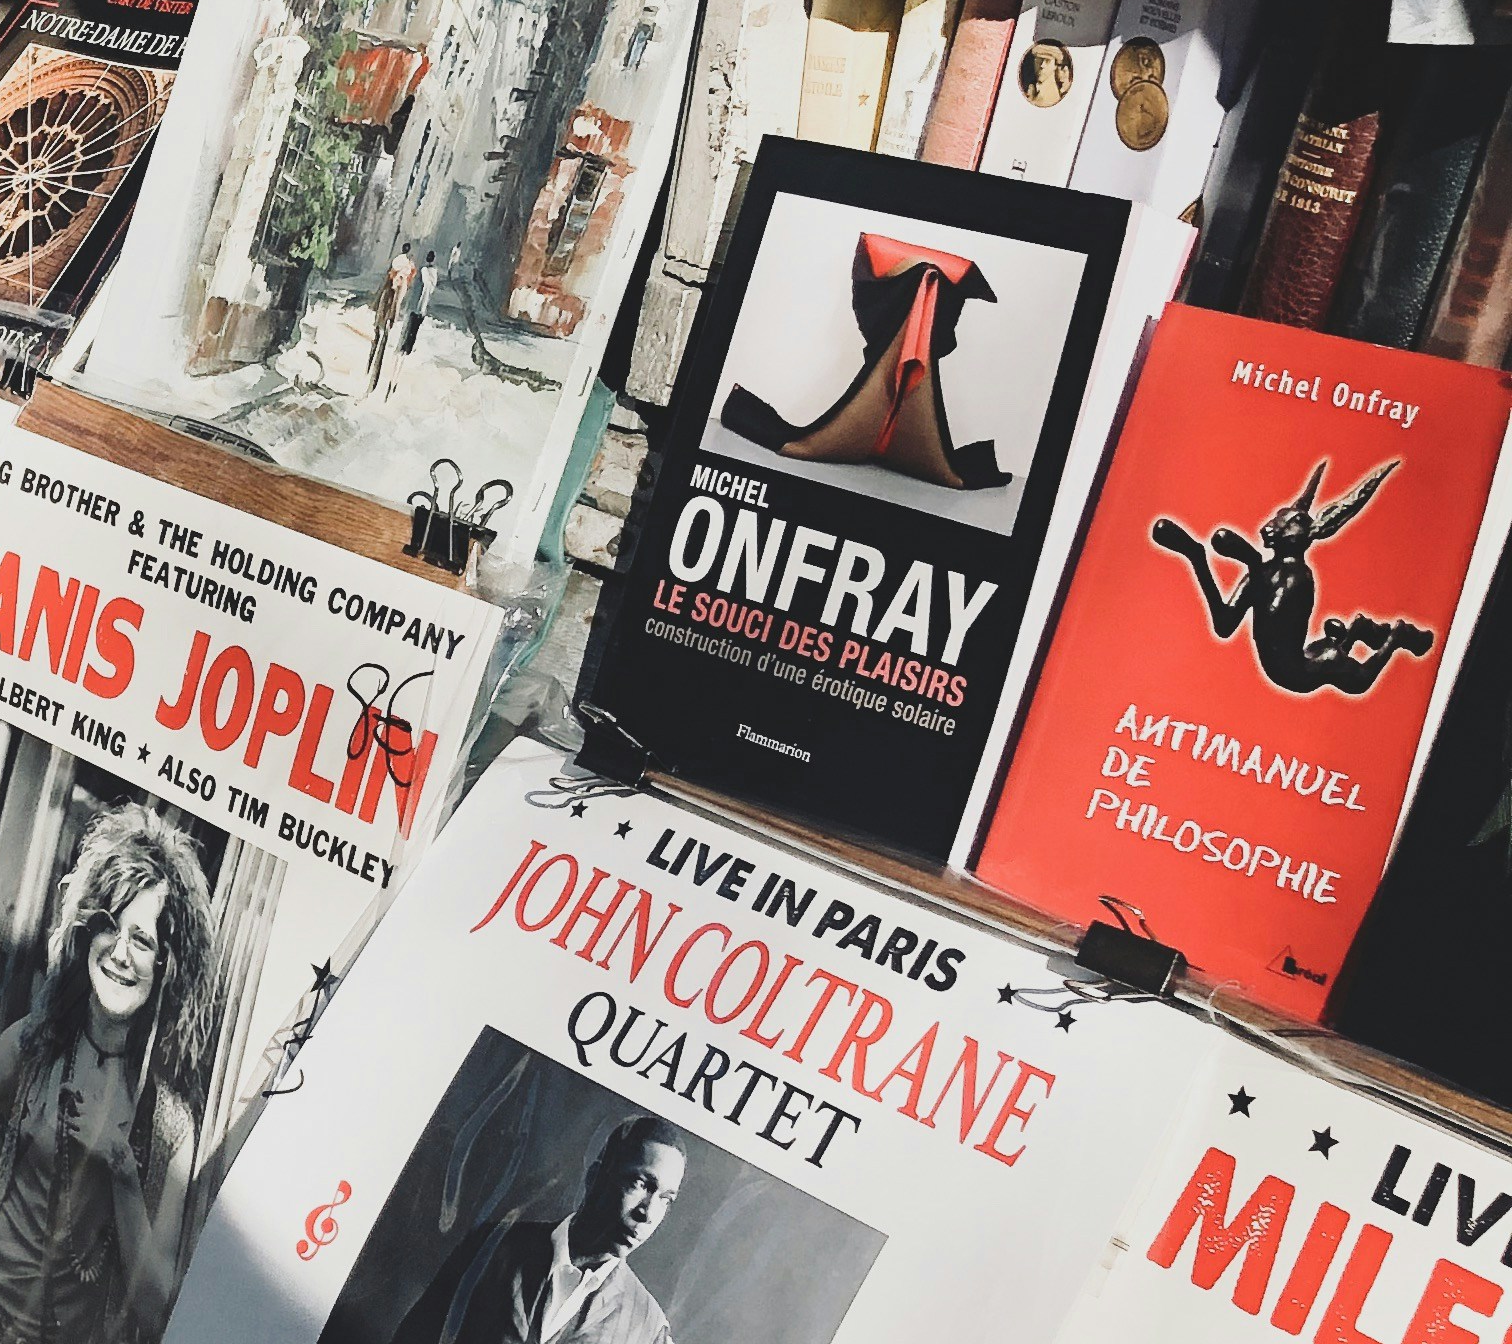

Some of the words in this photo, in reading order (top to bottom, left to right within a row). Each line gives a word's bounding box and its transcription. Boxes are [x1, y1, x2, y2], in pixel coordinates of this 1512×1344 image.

[20, 9, 152, 54] NOTRE-DAME
[145, 34, 180, 57] DE
[1041, 9, 1076, 27] LEROUX
[1290, 175, 1357, 204] CONSCRIT
[1290, 195, 1321, 214] 1813
[1230, 359, 1321, 402] Michel
[1331, 381, 1421, 429] Onfray
[689, 463, 770, 509] MICHEL
[20, 471, 121, 527] BROTHER
[209, 540, 317, 604] HOLDING
[327, 586, 466, 660] COMPANY
[127, 552, 257, 623] FEATURING
[667, 494, 1000, 668] ONFRAY
[644, 616, 753, 667] construction
[810, 668, 889, 713] érotique
[890, 700, 957, 736] solaire
[690, 591, 774, 644] SOUCI
[838, 639, 968, 708] PLAISIRS
[71, 712, 127, 759] KING
[155, 629, 439, 841] JOPLIN
[735, 722, 812, 763] Flammarion
[1113, 703, 1367, 812] ANTIMANUEL
[277, 814, 397, 890] BUCKLEY
[1085, 788, 1341, 905] PHILOSOPHIE
[645, 827, 756, 904] LIVE
[752, 877, 818, 928] IN
[812, 900, 967, 994] PARIS
[470, 838, 685, 985] JOHN
[662, 921, 1056, 1168] COLTRANE
[566, 990, 862, 1170] QUARTET
